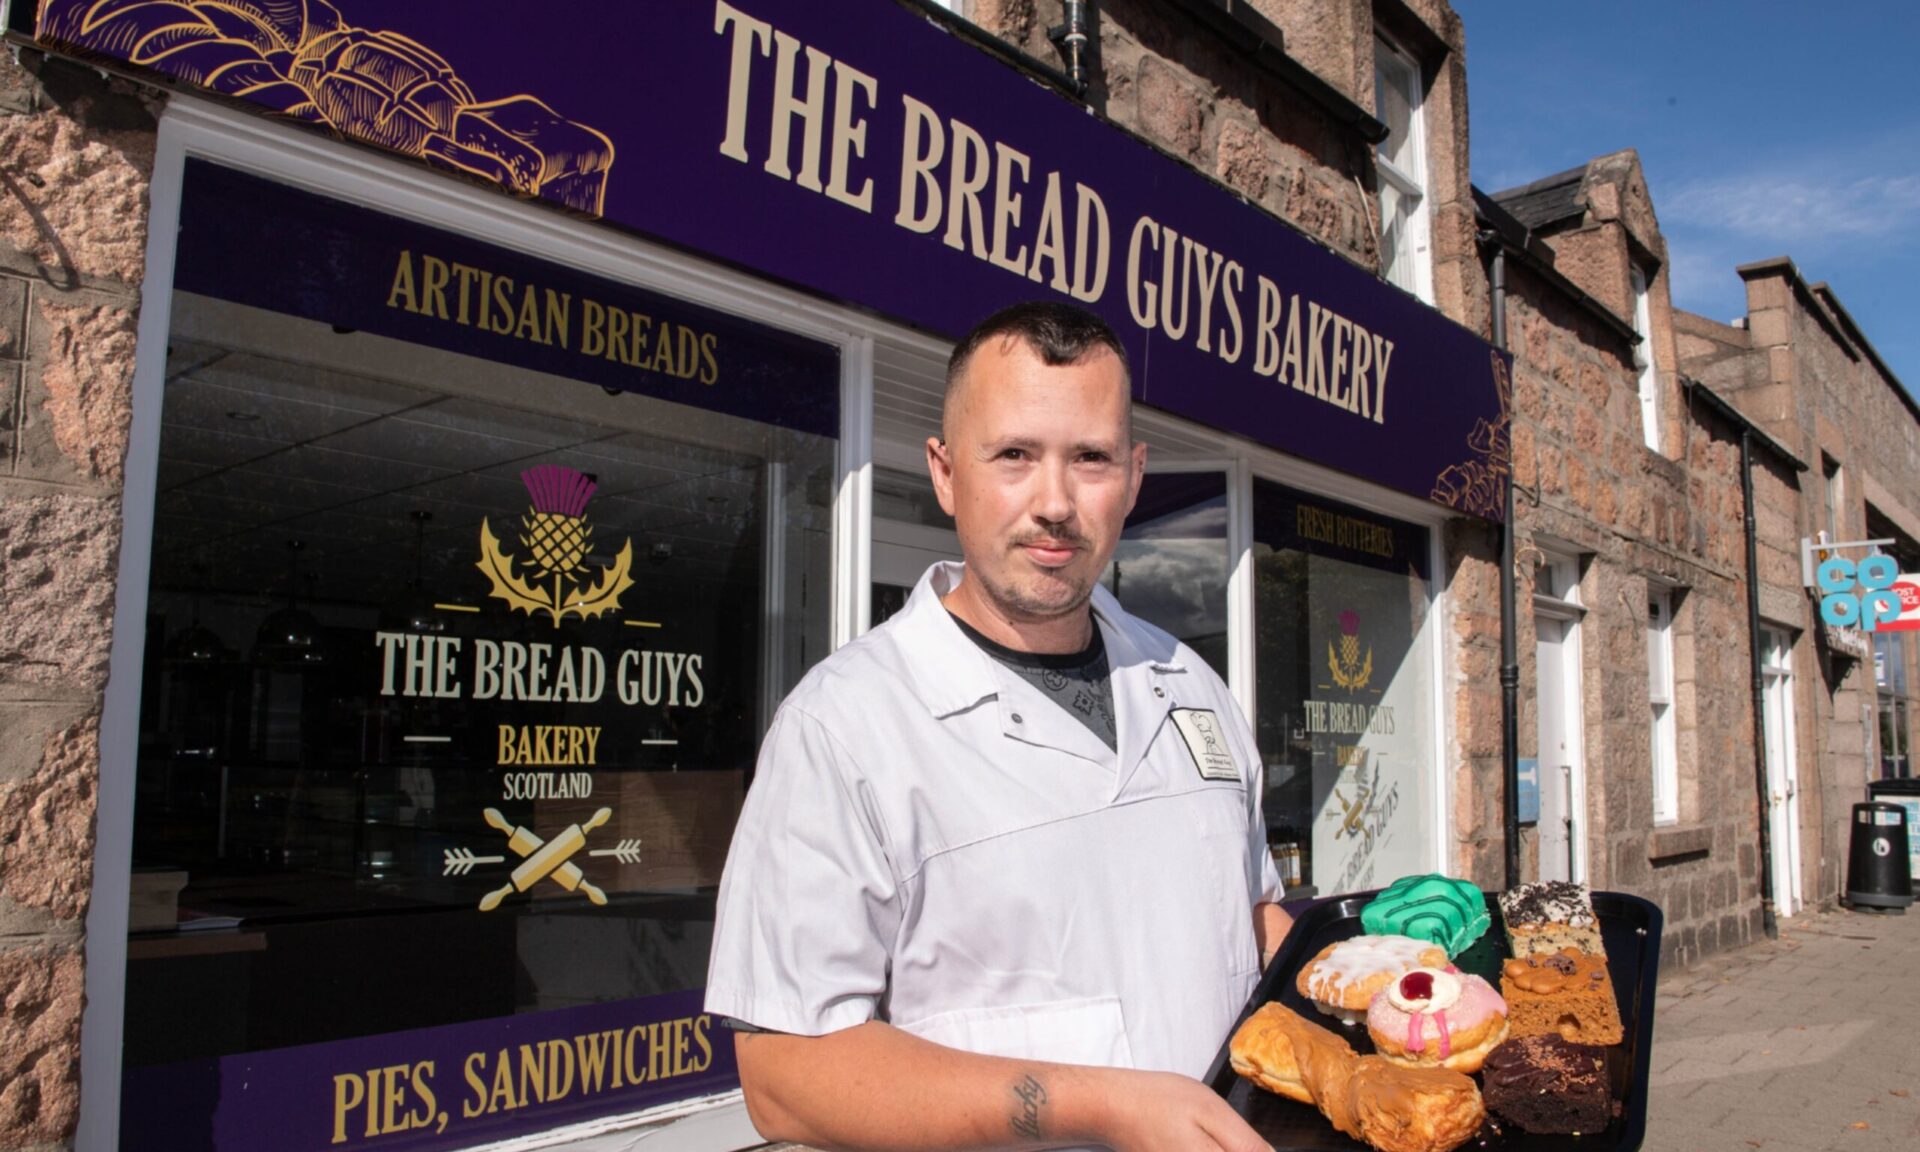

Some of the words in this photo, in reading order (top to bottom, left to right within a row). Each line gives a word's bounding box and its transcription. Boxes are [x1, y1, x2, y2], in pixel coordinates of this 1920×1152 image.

[715, 0, 877, 214] THE
[895, 94, 1111, 304] BREAD
[1126, 215, 1244, 364] GUYS
[1253, 275, 1395, 425] BAKERY
[387, 249, 573, 350] ARTISAN
[580, 298, 719, 386] BREADS
[1296, 503, 1335, 545] FRESH
[1337, 513, 1395, 559] BUTTERIES
[376, 631, 462, 699] THE
[472, 638, 606, 704] BREAD
[616, 648, 704, 708] GUYS
[497, 724, 602, 766] BAKERY
[1303, 700, 1328, 733] THE
[1328, 702, 1367, 734] BREAD
[1368, 704, 1396, 736] GUYS
[503, 772, 593, 801] SCOTLAND
[331, 1060, 449, 1144] PIES,
[463, 1014, 713, 1120] SANDWICHES
